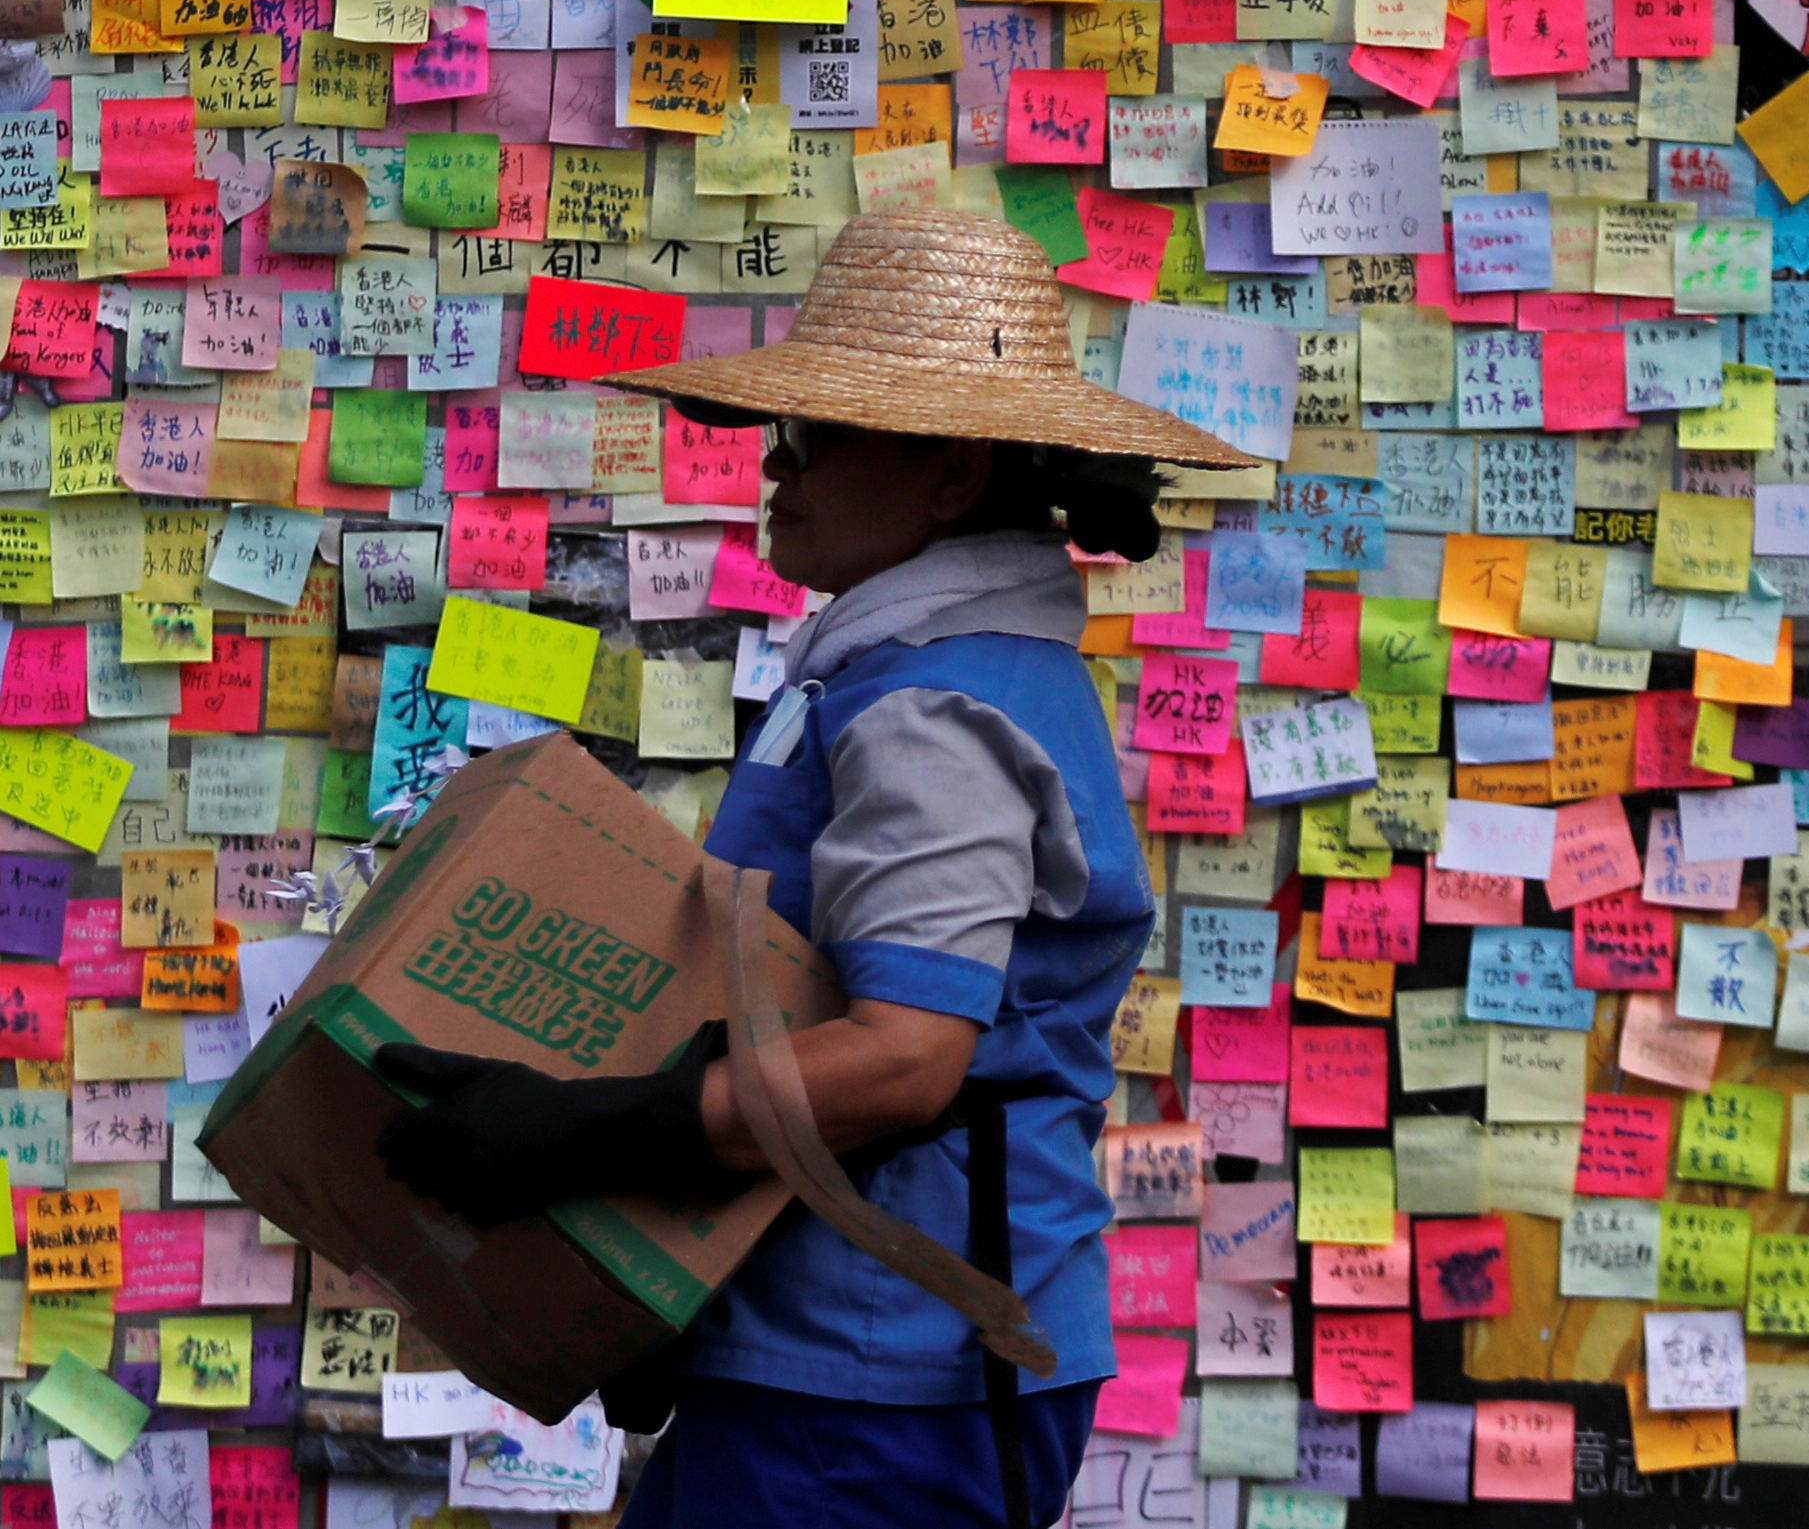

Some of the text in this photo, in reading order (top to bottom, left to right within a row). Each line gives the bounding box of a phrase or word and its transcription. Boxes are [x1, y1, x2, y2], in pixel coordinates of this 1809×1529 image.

[402, 929, 623, 1068] 由我做先
[451, 876, 676, 1013] GO GREEN
